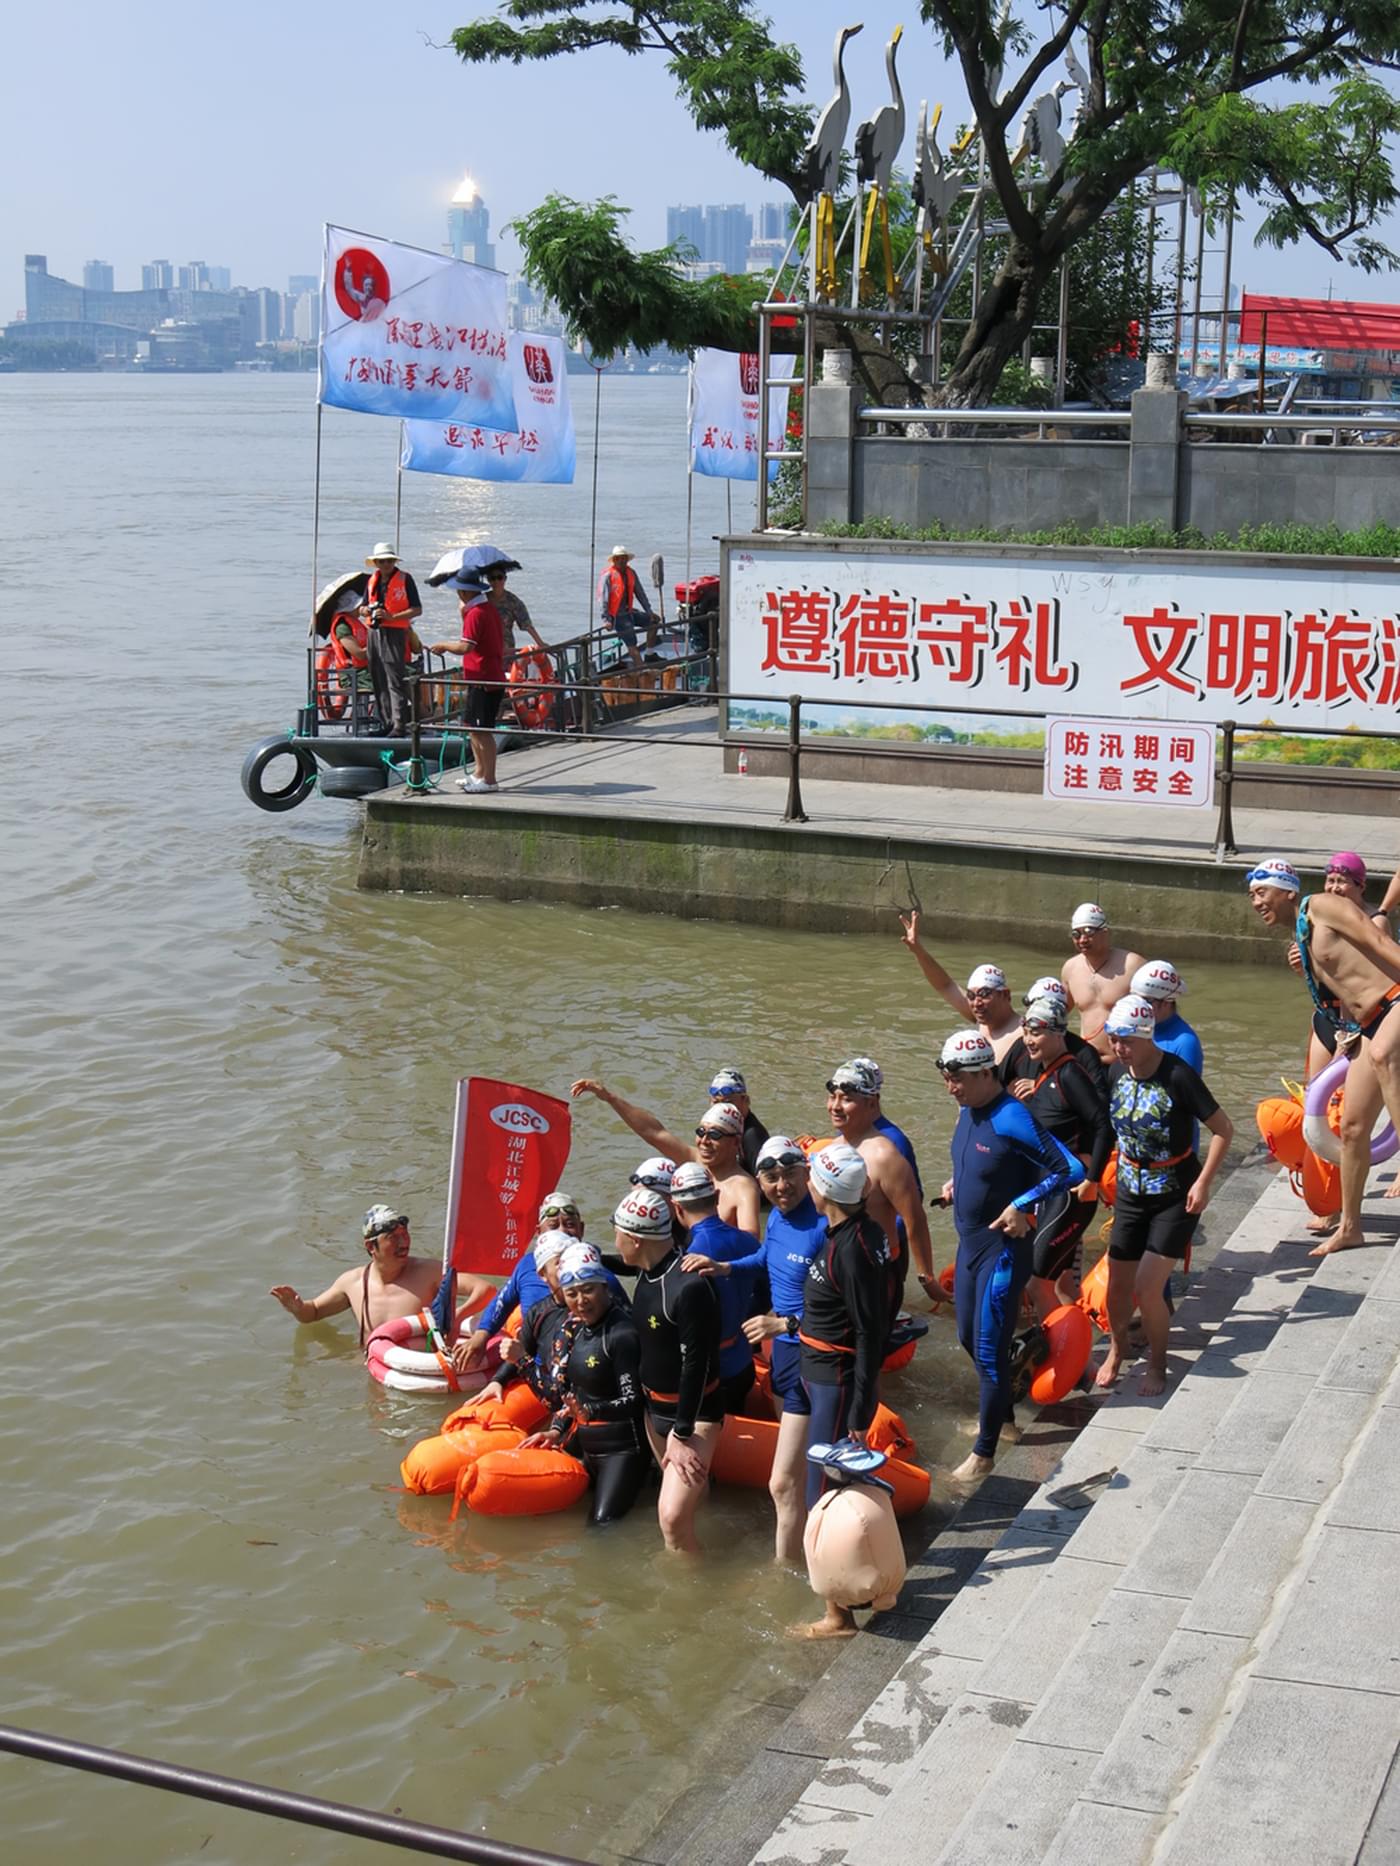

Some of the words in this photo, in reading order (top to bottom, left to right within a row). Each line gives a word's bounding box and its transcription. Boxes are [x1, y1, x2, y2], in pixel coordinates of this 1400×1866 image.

[761, 588, 1071, 688] 遵德守礼
[1065, 731, 1195, 763] 防汛期间
[1064, 764, 1193, 796] 注意安全
[499, 1109, 542, 1130] JCSC
[622, 1199, 661, 1221] JCSC
[786, 1252, 813, 1265] JCSC
